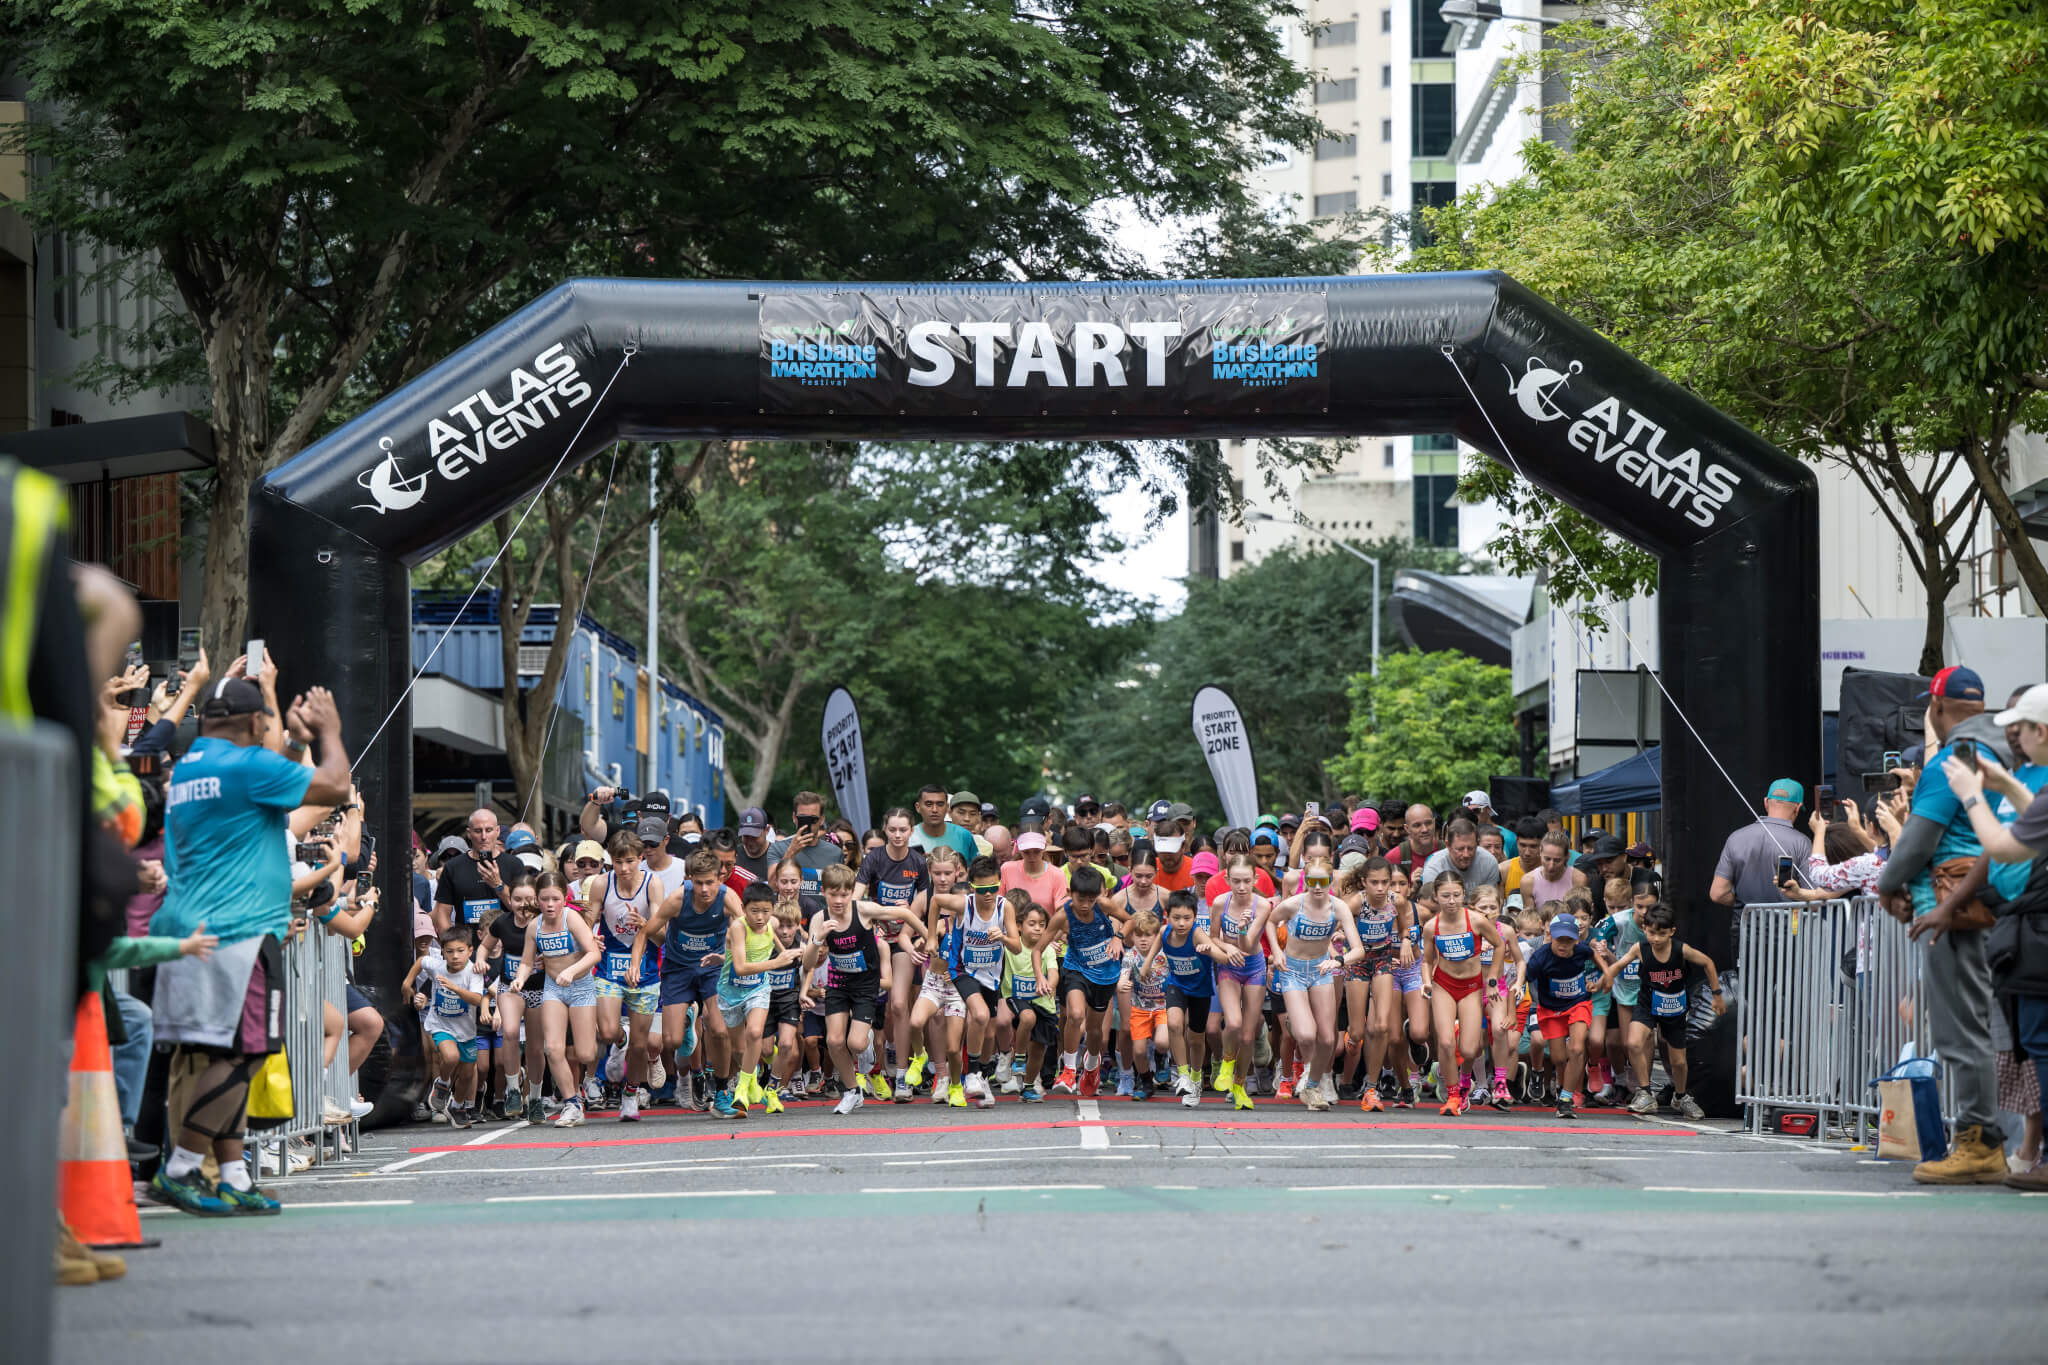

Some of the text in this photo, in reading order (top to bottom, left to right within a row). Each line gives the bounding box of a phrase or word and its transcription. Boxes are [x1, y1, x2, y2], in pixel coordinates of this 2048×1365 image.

[771, 339, 876, 362] Brisbane
[907, 321, 1182, 387] START
[1213, 340, 1317, 362] Brisbane
[771, 362, 876, 378] MARATHON
[1213, 363, 1317, 379] MARATHON
[801, 378, 847, 387] Festival
[1242, 379, 1288, 387] Festival
[428, 342, 576, 458] ATLAS
[437, 371, 592, 480] EVENTS
[1582, 396, 1742, 503] ATLAS
[1567, 420, 1722, 528] EVENTS
[1202, 710, 1235, 722] PRIORITY
[827, 713, 854, 744] PRIORITY
[1205, 721, 1237, 737] START
[1208, 737, 1240, 755] ZONE
[882, 887, 911, 898] 16455
[1299, 926, 1331, 936] 16637
[539, 936, 569, 950] 16557
[834, 936, 856, 945] WATTS
[1649, 969, 1683, 983] BULLS
